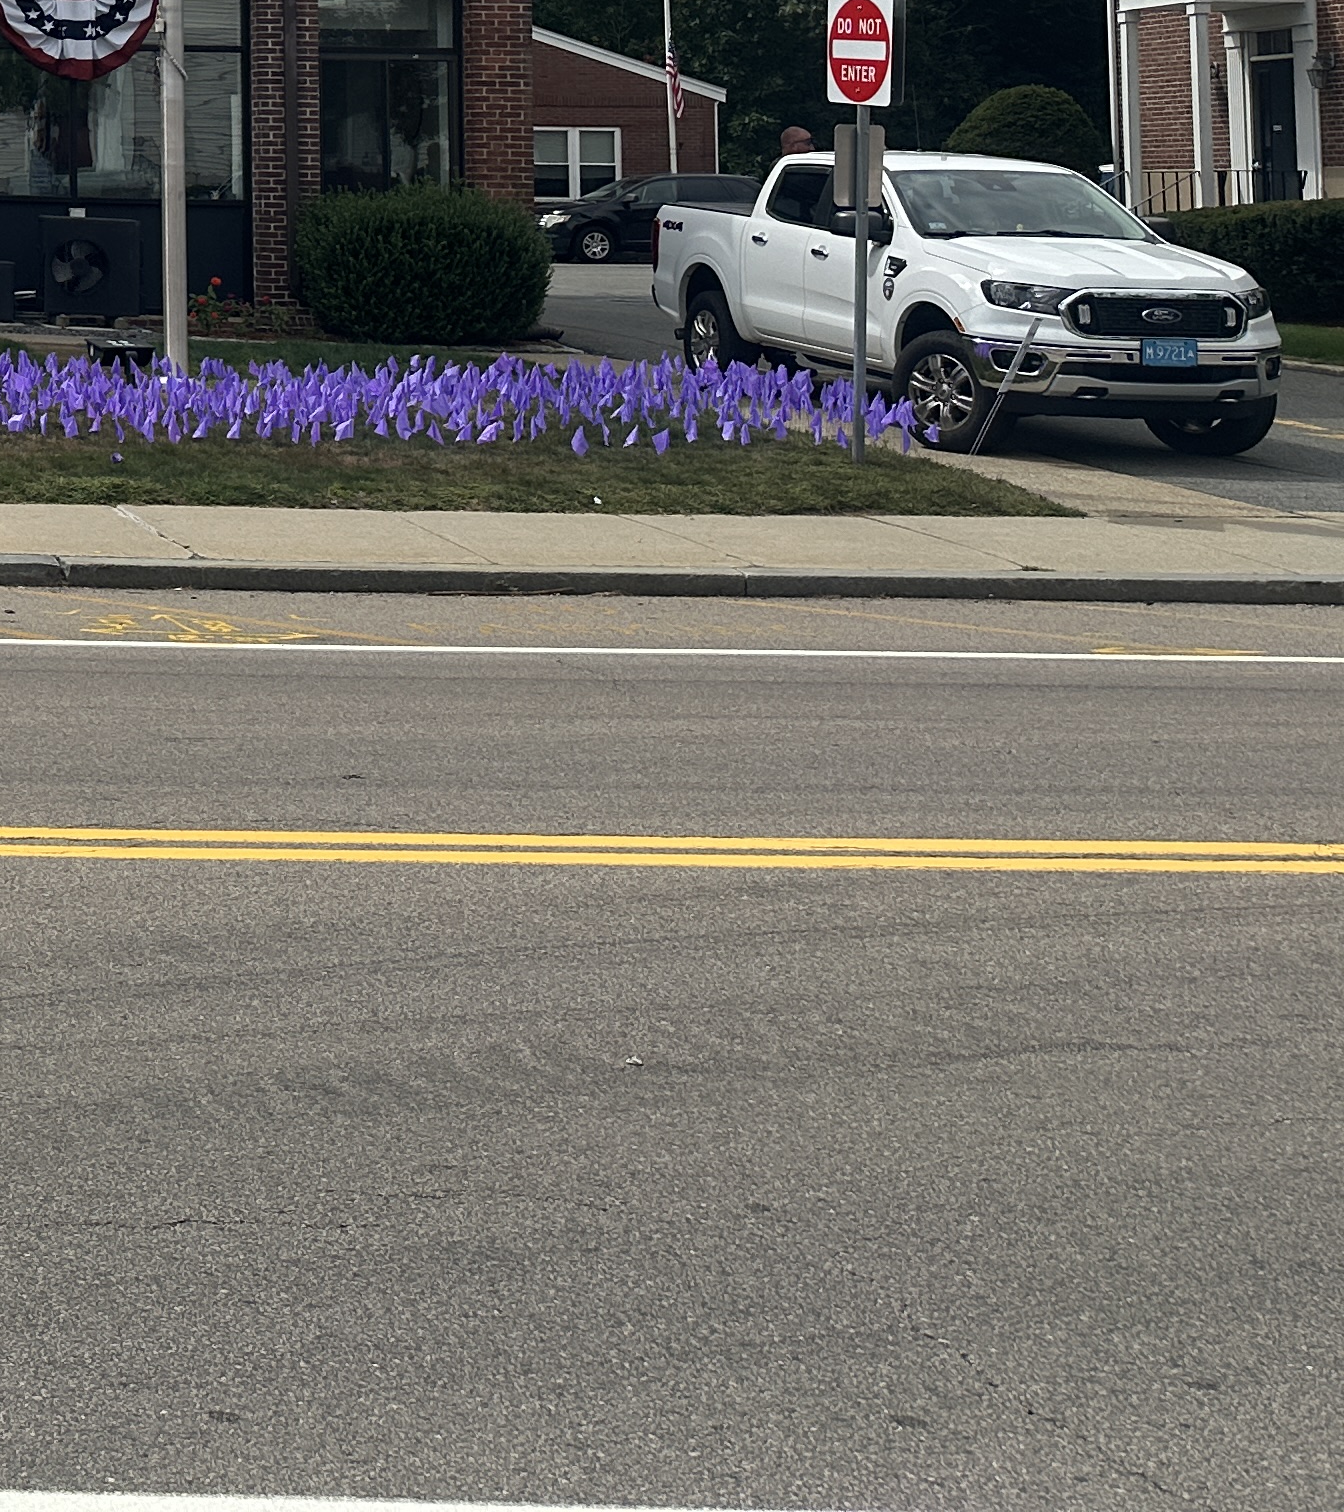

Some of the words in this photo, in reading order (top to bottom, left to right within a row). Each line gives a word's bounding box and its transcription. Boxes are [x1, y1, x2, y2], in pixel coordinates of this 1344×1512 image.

[837, 17, 852, 34] DO
[858, 18, 882, 35] NOT
[841, 64, 876, 83] ENTER
